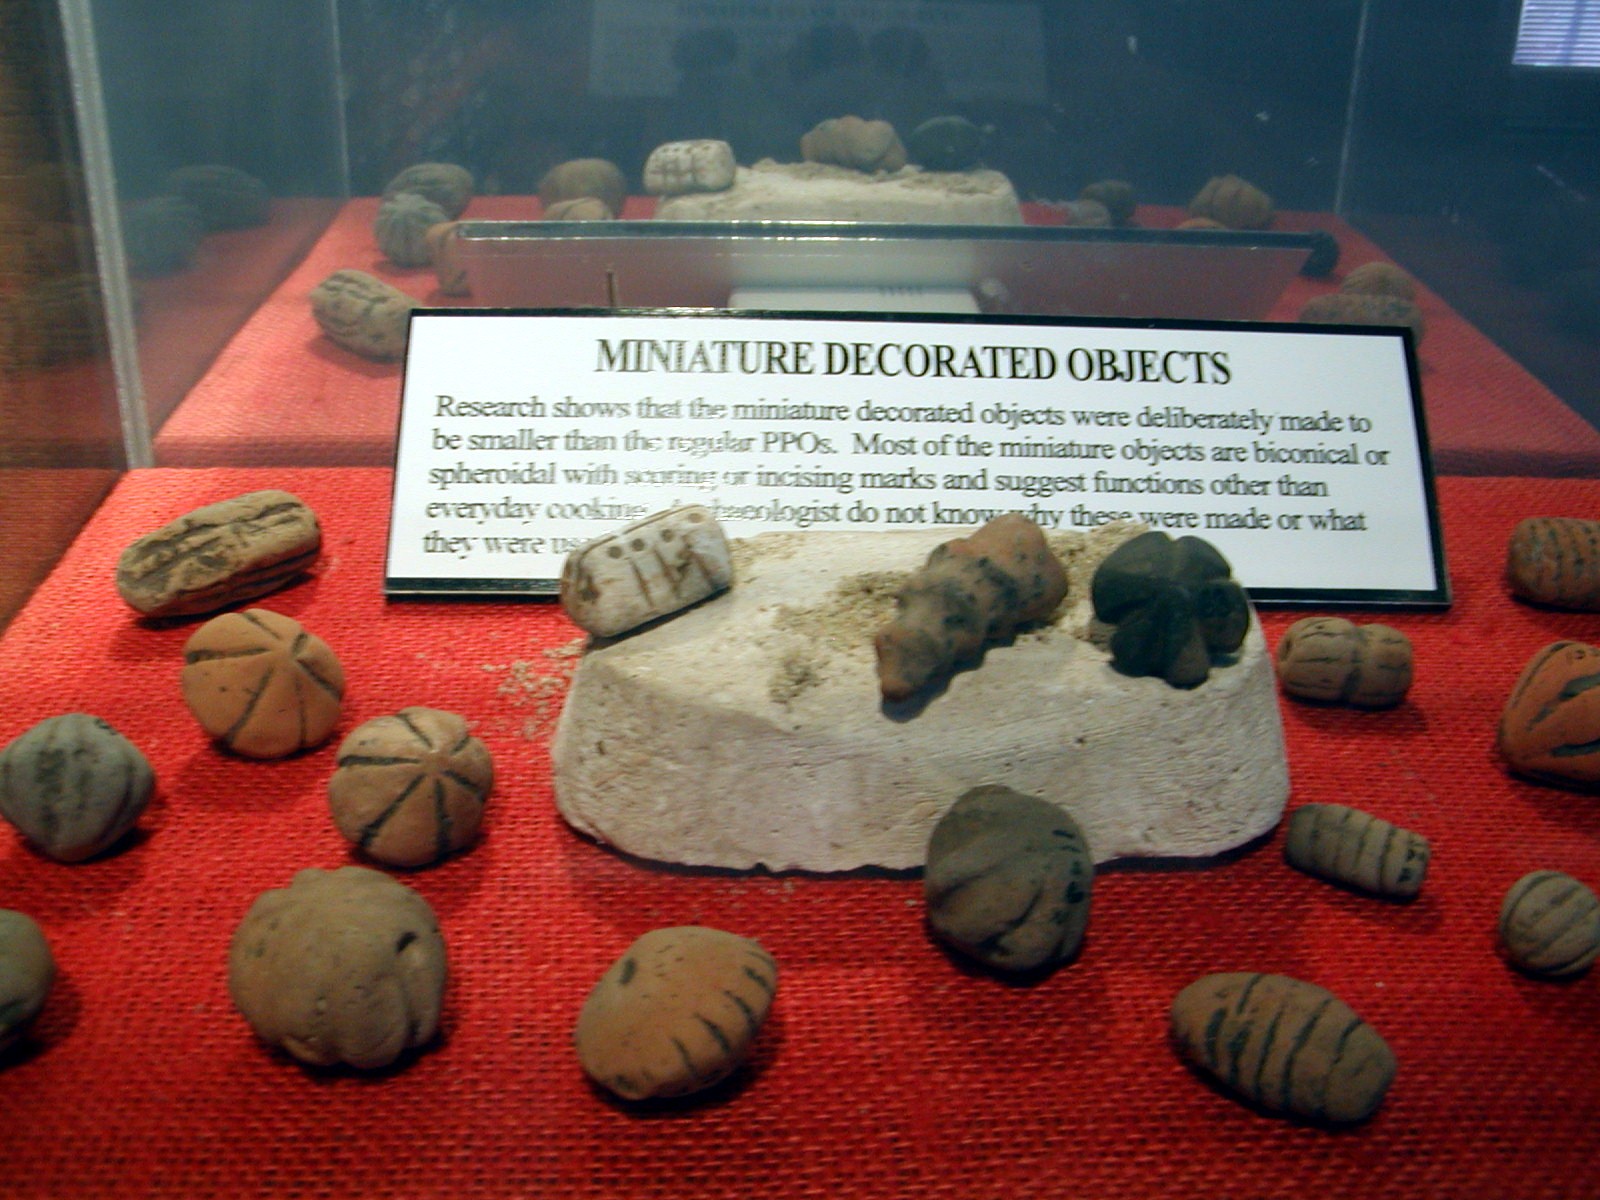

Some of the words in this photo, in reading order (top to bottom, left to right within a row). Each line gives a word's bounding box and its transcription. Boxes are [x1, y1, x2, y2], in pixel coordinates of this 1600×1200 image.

[594, 338, 815, 374] MINIATURE
[822, 341, 1057, 378] DECORATED
[1067, 347, 1232, 383] OBJECTS
[434, 394, 546, 417] Research
[551, 395, 632, 418] shows
[636, 396, 682, 418] that
[687, 396, 728, 419] the
[730, 397, 850, 421] miniature
[856, 399, 974, 423] decorated
[980, 403, 1065, 431] objects
[1072, 408, 1131, 427] were
[1136, 406, 1273, 435] deliberately
[1278, 410, 1342, 431] made
[1347, 413, 1372, 432] to
[431, 427, 464, 449] be
[469, 428, 559, 450] smaller
[564, 429, 619, 450] than
[624, 429, 660, 451] the
[668, 430, 757, 458] regular
[760, 432, 838, 453] PPOs.
[850, 432, 918, 455] Most
[922, 434, 954, 455] of
[955, 434, 994, 456] the
[999, 436, 1116, 459] miniature
[1120, 439, 1205, 465] objects
[1211, 444, 1249, 461] are
[1254, 440, 1359, 464] biconical
[1363, 447, 1391, 464] or
[427, 461, 557, 489] spheroidal
[562, 463, 621, 484] with
[624, 464, 717, 489] scoring
[722, 468, 752, 485] or
[755, 465, 854, 491] incising
[859, 466, 937, 488] marks
[942, 468, 988, 489] and
[994, 473, 1087, 496] suggest
[1092, 471, 1204, 494] functions
[1210, 473, 1271, 495] other
[1276, 475, 1329, 496] than
[425, 496, 541, 523] everyday
[846, 500, 879, 521] do
[884, 504, 929, 523] not
[1140, 510, 1199, 527] were
[1203, 507, 1270, 528] made
[1277, 513, 1303, 528] or
[1306, 510, 1367, 529] what
[422, 531, 478, 558] they
[483, 535, 546, 552] were
